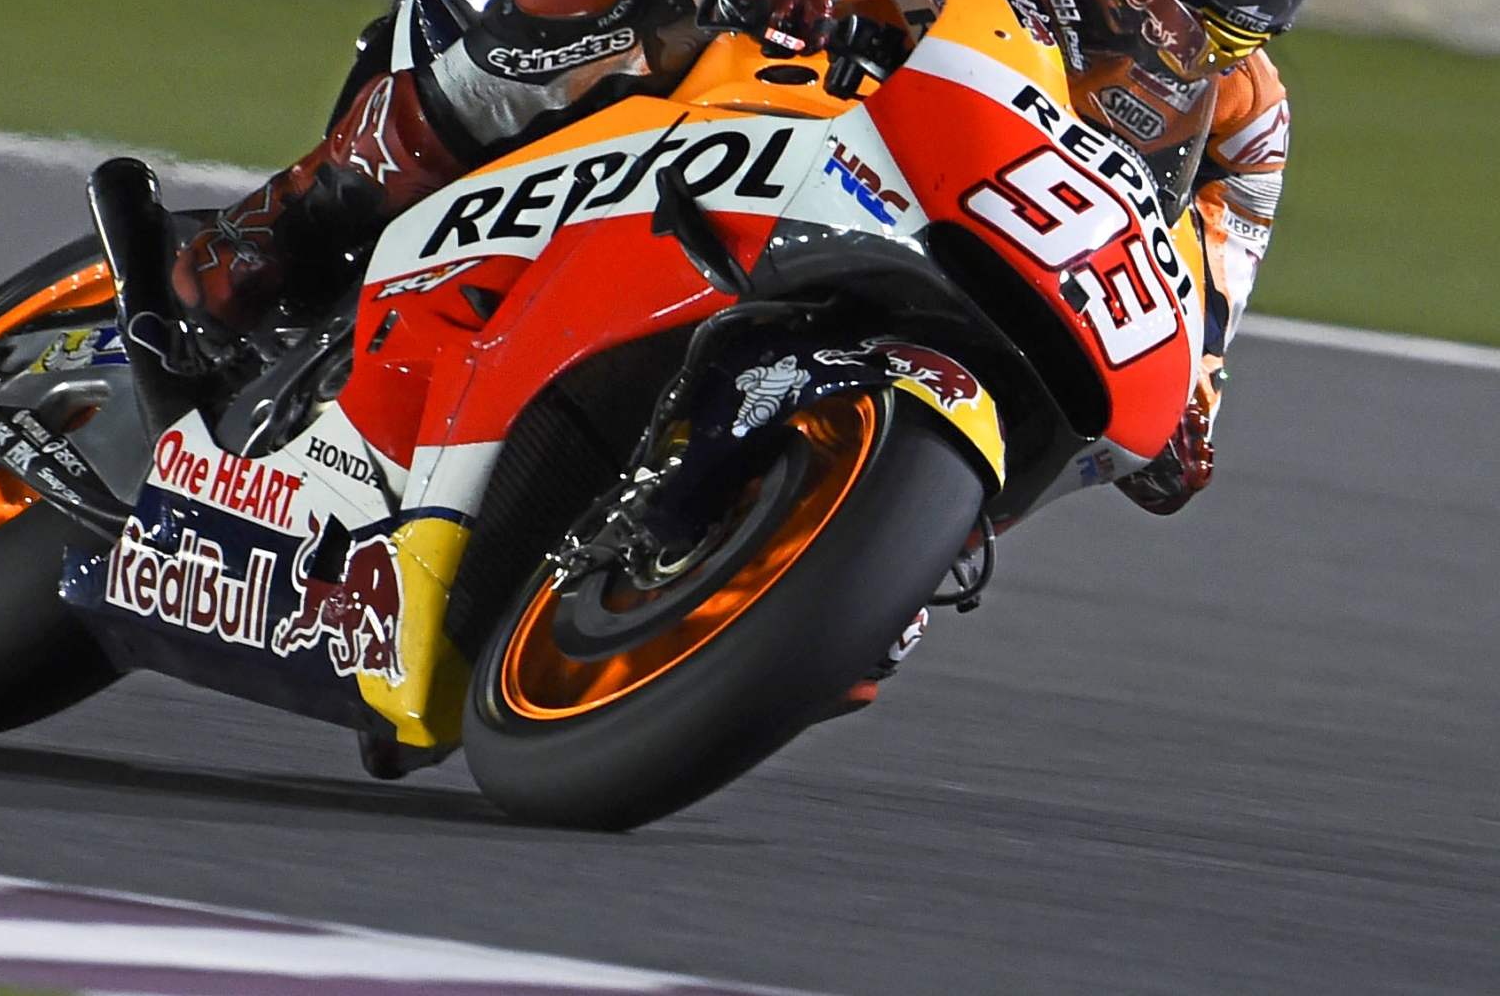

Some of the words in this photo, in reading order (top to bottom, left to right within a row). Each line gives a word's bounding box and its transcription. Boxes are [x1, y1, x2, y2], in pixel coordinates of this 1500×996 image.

[769, 29, 798, 49] 93
[1226, 8, 1270, 33] LOTUS
[1067, 29, 1085, 72] Puig
[1105, 91, 1160, 136] SHOEI
[419, 128, 793, 259] REPSOL
[824, 140, 910, 226] HRC
[1012, 85, 1192, 316] REPSOL
[963, 145, 1179, 368] 93
[7, 440, 40, 471] RK
[155, 430, 209, 494] One
[307, 436, 384, 490] HONDA
